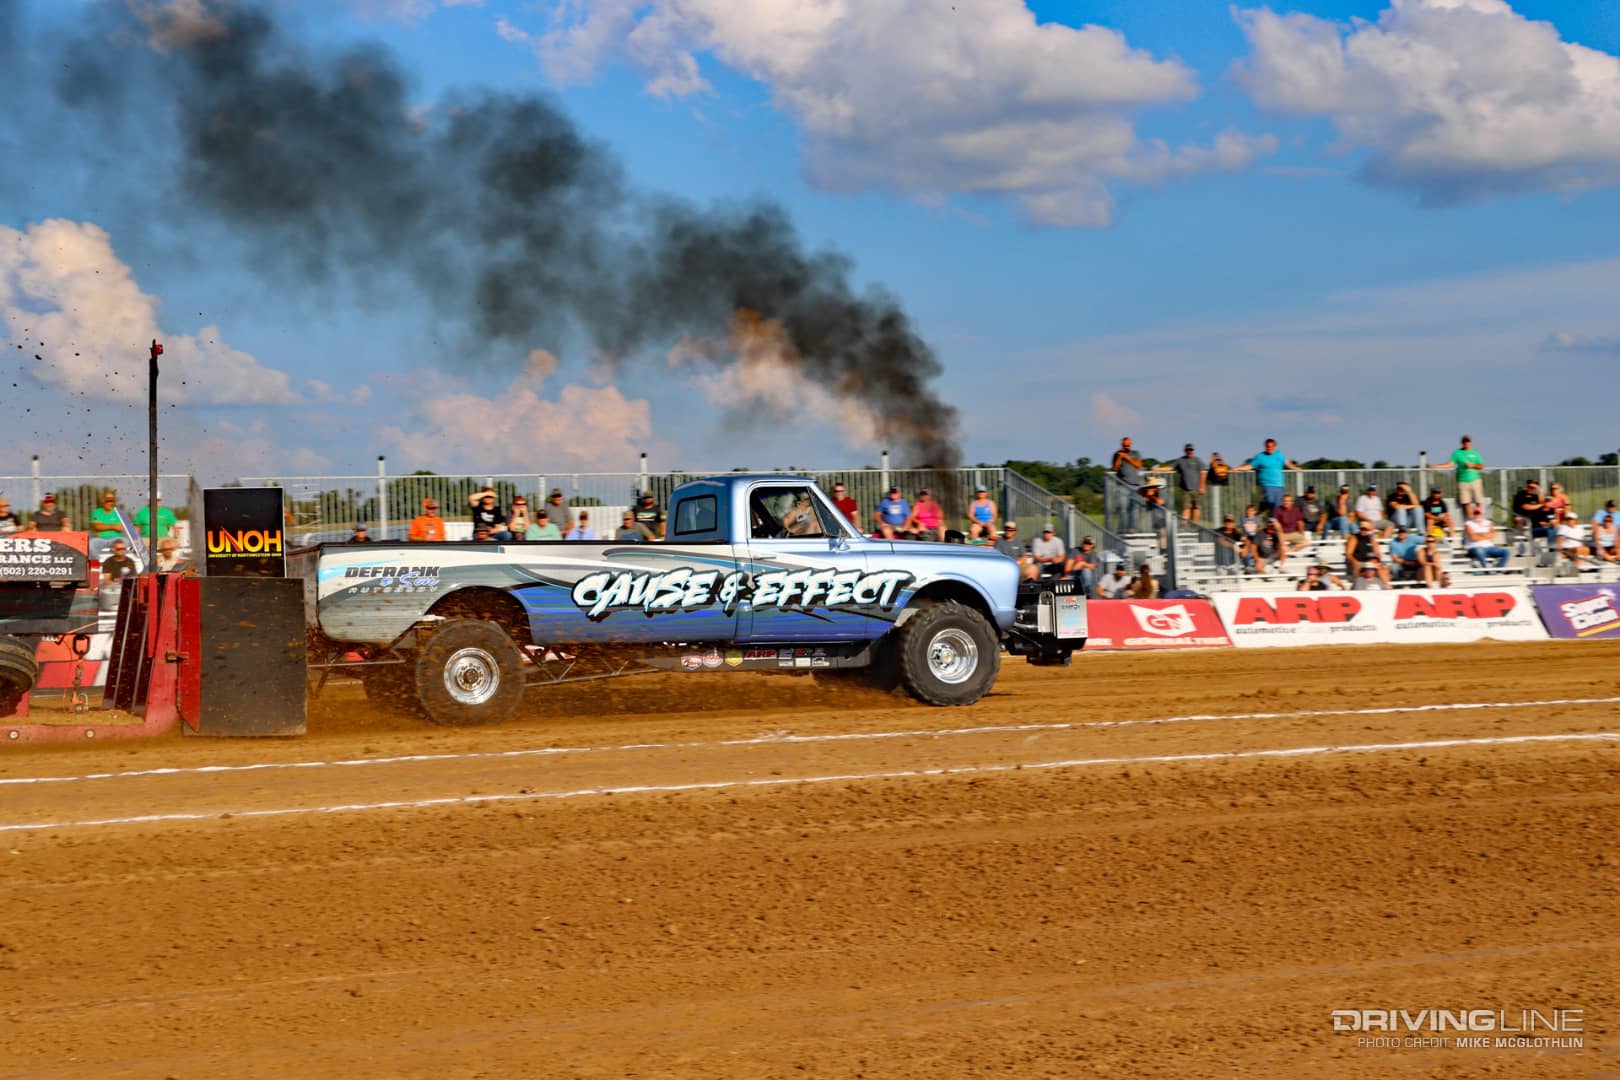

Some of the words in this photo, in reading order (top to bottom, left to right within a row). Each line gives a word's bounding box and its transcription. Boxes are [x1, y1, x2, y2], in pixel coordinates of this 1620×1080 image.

[0, 538, 52, 553] ERS
[207, 529, 282, 553] UNOH
[0, 554, 52, 564] RANCE
[53, 556, 74, 564] LLC
[0, 566, 26, 576] (502)
[28, 567, 73, 576] 220-0291
[344, 566, 440, 578] DEFRANK
[572, 567, 722, 618] CAUSE
[718, 572, 748, 613] &
[752, 568, 915, 607] EFFECT
[1233, 596, 1362, 625] ARP
[1393, 592, 1517, 620] ARP
